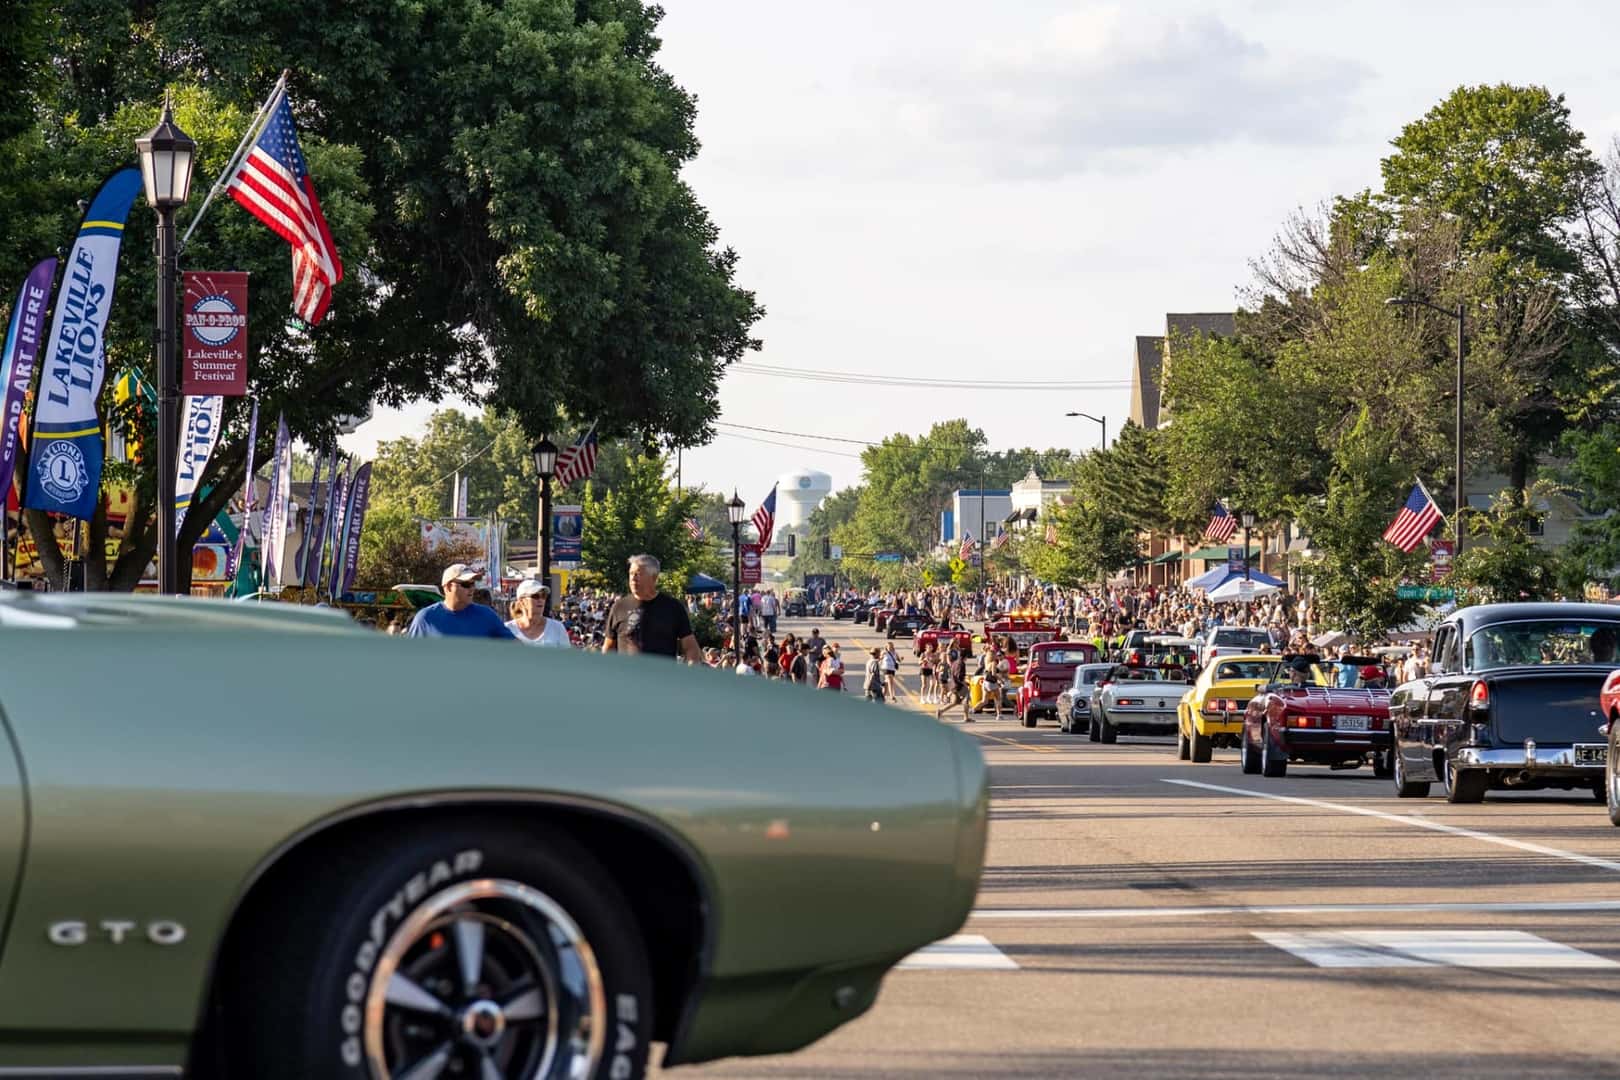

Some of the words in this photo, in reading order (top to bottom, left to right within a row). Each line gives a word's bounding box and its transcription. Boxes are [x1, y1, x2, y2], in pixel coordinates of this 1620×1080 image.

[21, 286, 44, 343] HERE
[48, 247, 94, 408] LAKEVILLE
[70, 281, 105, 393] LIONS
[187, 349, 242, 359] Lakeville's
[192, 360, 237, 370] Summer
[14, 349, 33, 392] ART
[194, 371, 235, 381] Festival
[194, 396, 214, 461] LION
[51, 443, 81, 460] LIONS
[58, 460, 71, 483] L
[351, 511, 364, 534] ART
[49, 920, 186, 945] GTO
[341, 849, 483, 1067] GOODYEAR
